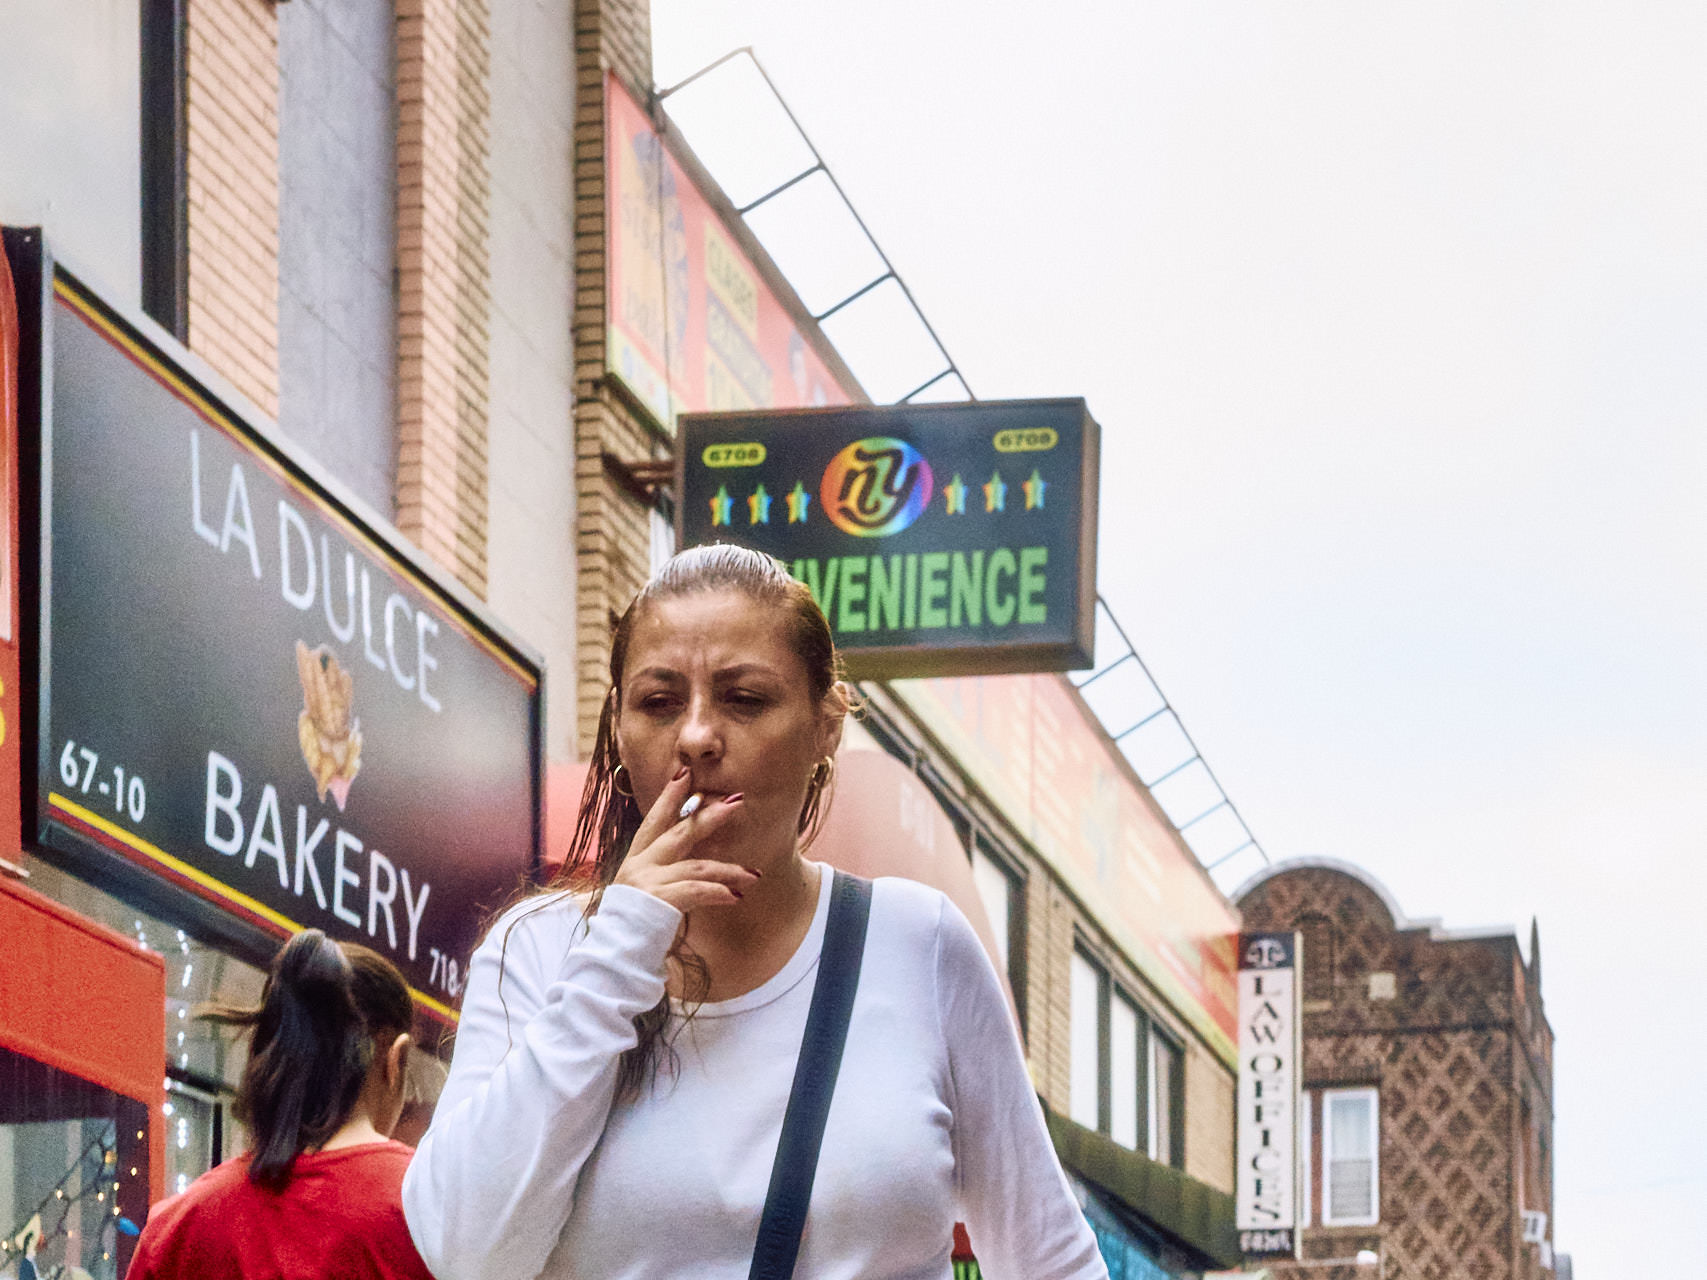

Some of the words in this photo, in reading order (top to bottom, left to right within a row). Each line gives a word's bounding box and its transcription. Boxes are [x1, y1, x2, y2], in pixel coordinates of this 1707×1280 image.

[190, 430, 263, 580] LA
[278, 500, 442, 713] DULCE
[793, 546, 1048, 632] VENIENCE
[60, 739, 146, 823] 67-10
[204, 751, 432, 962] BAKERY
[1249, 975, 1284, 1044] LAW
[1249, 1053, 1284, 1222] OFFICES
